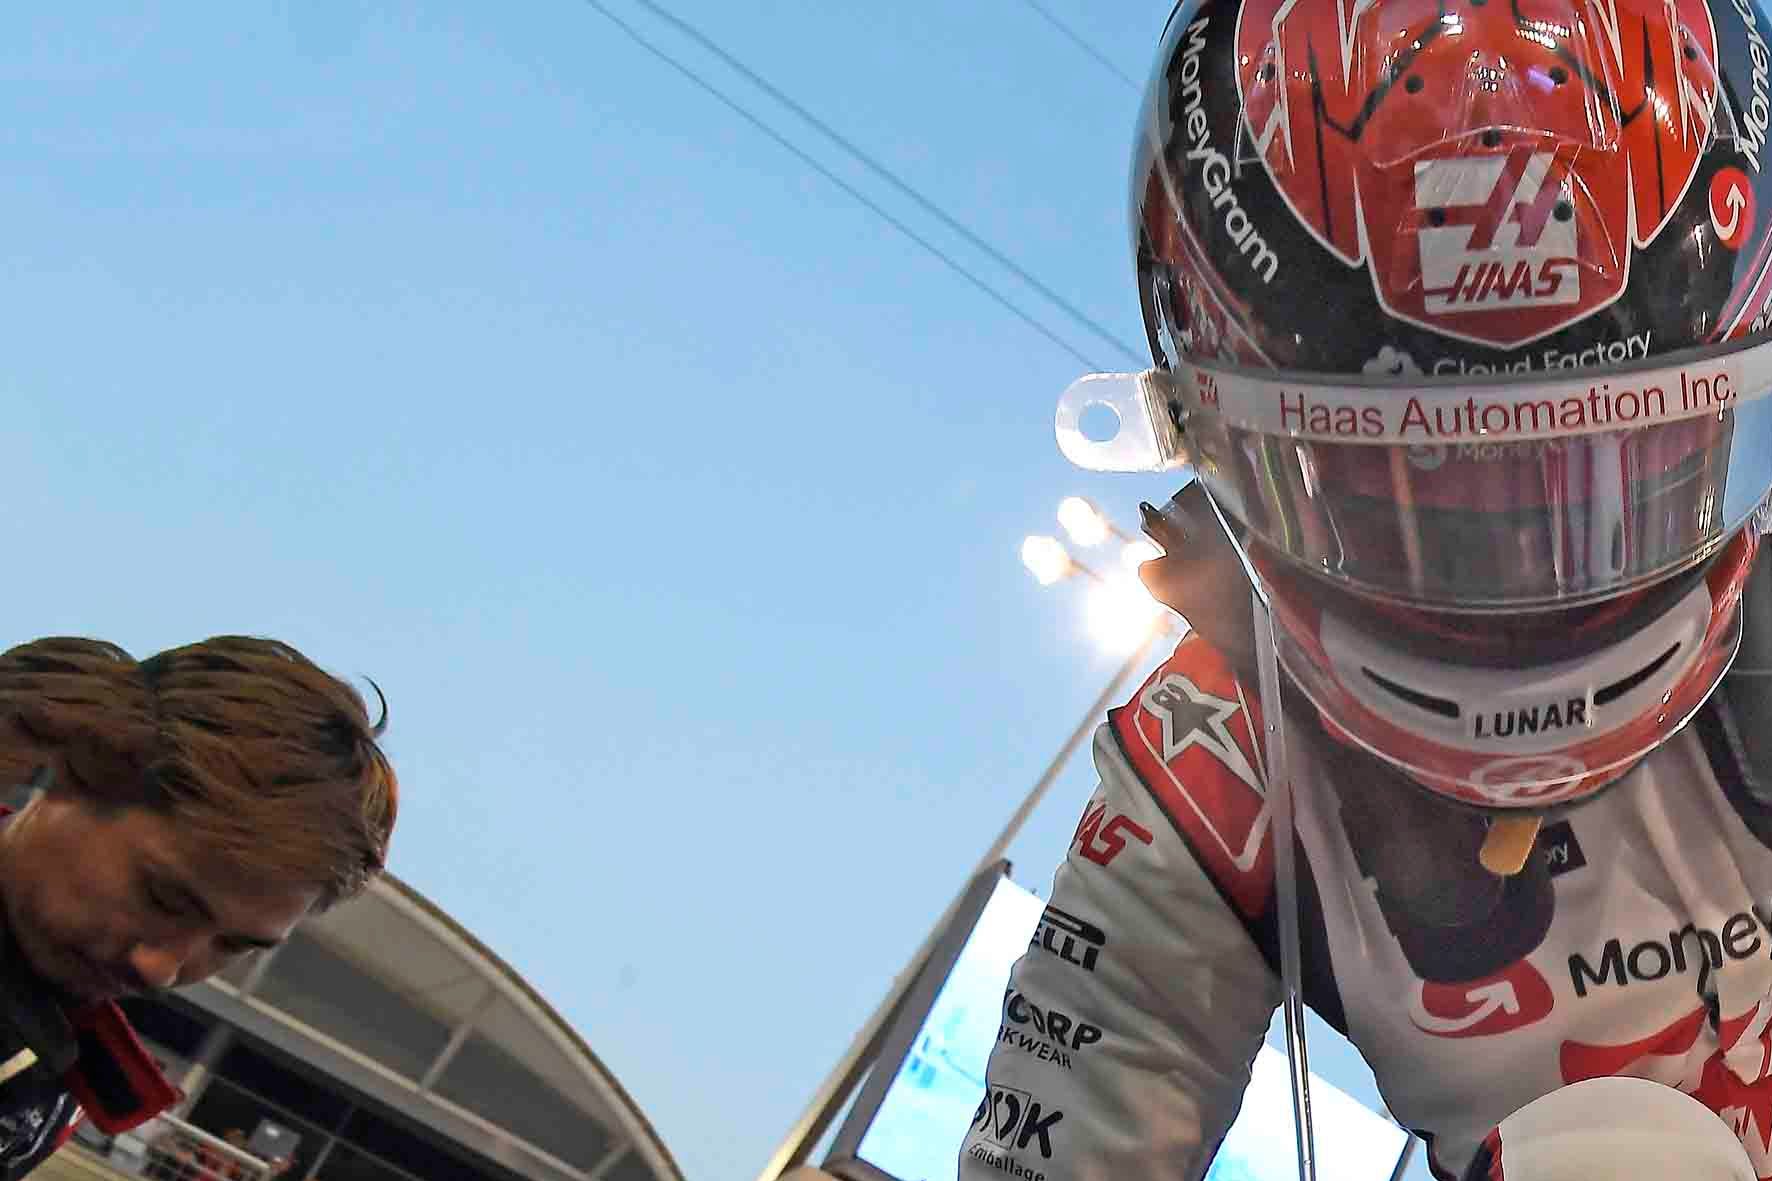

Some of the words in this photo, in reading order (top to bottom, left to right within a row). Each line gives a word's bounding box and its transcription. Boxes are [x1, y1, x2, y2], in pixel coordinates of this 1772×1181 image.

[1185, 16, 1279, 284] MoneyGram
[1423, 257, 1577, 304] HAAS
[1543, 331, 1651, 374] Factory
[1279, 391, 1386, 438] Haas
[1399, 384, 1666, 438] Automation
[1679, 370, 1738, 412] Inc.
[1474, 697, 1586, 740] LUNAR
